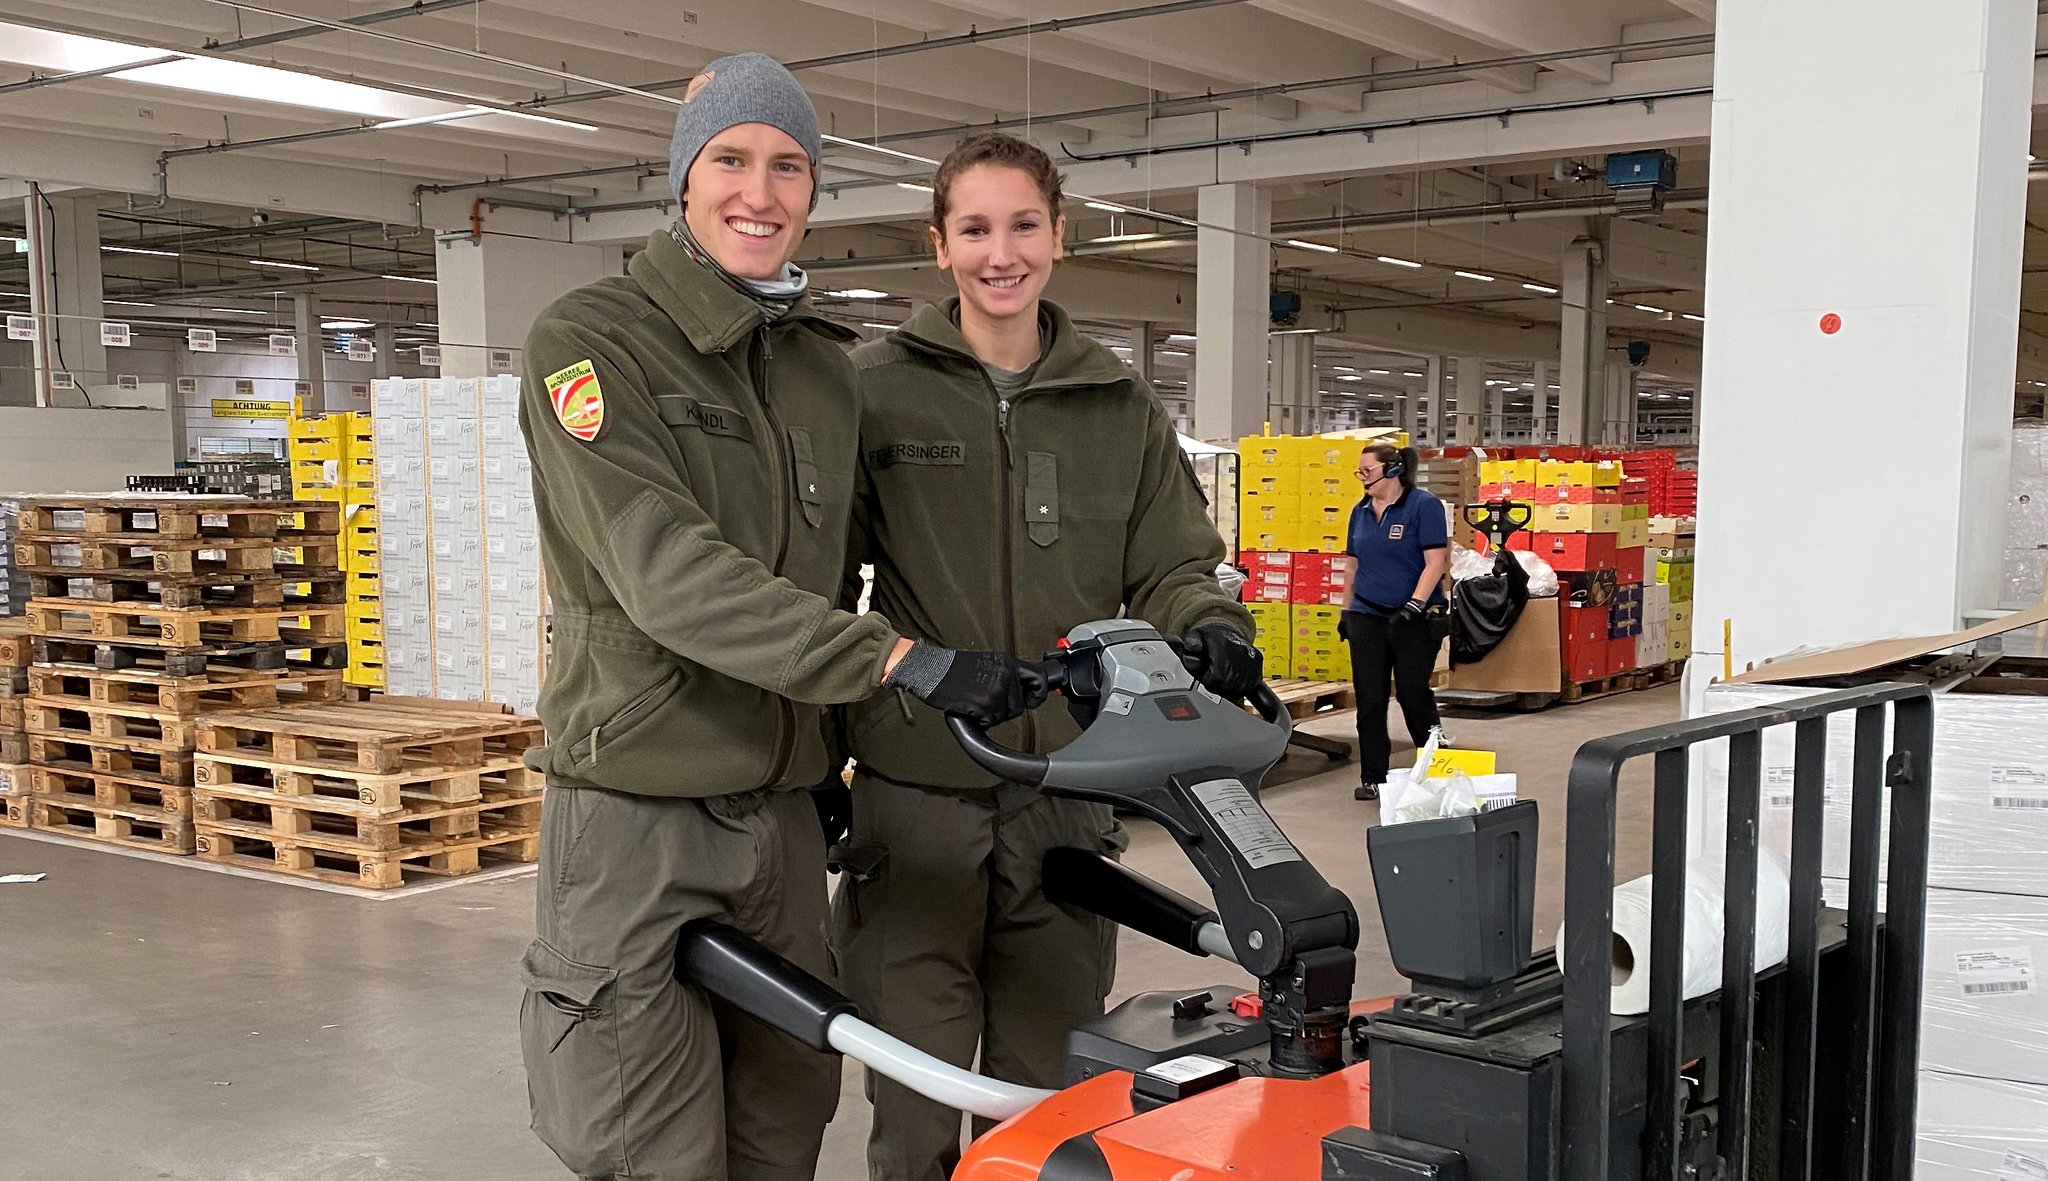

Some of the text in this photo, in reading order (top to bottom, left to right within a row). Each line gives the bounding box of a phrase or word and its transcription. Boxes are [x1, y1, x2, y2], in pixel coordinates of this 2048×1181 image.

[233, 402, 271, 410] ACHTUNG
[686, 404, 728, 430] KNDL
[869, 444, 960, 460] FEERSINGER
